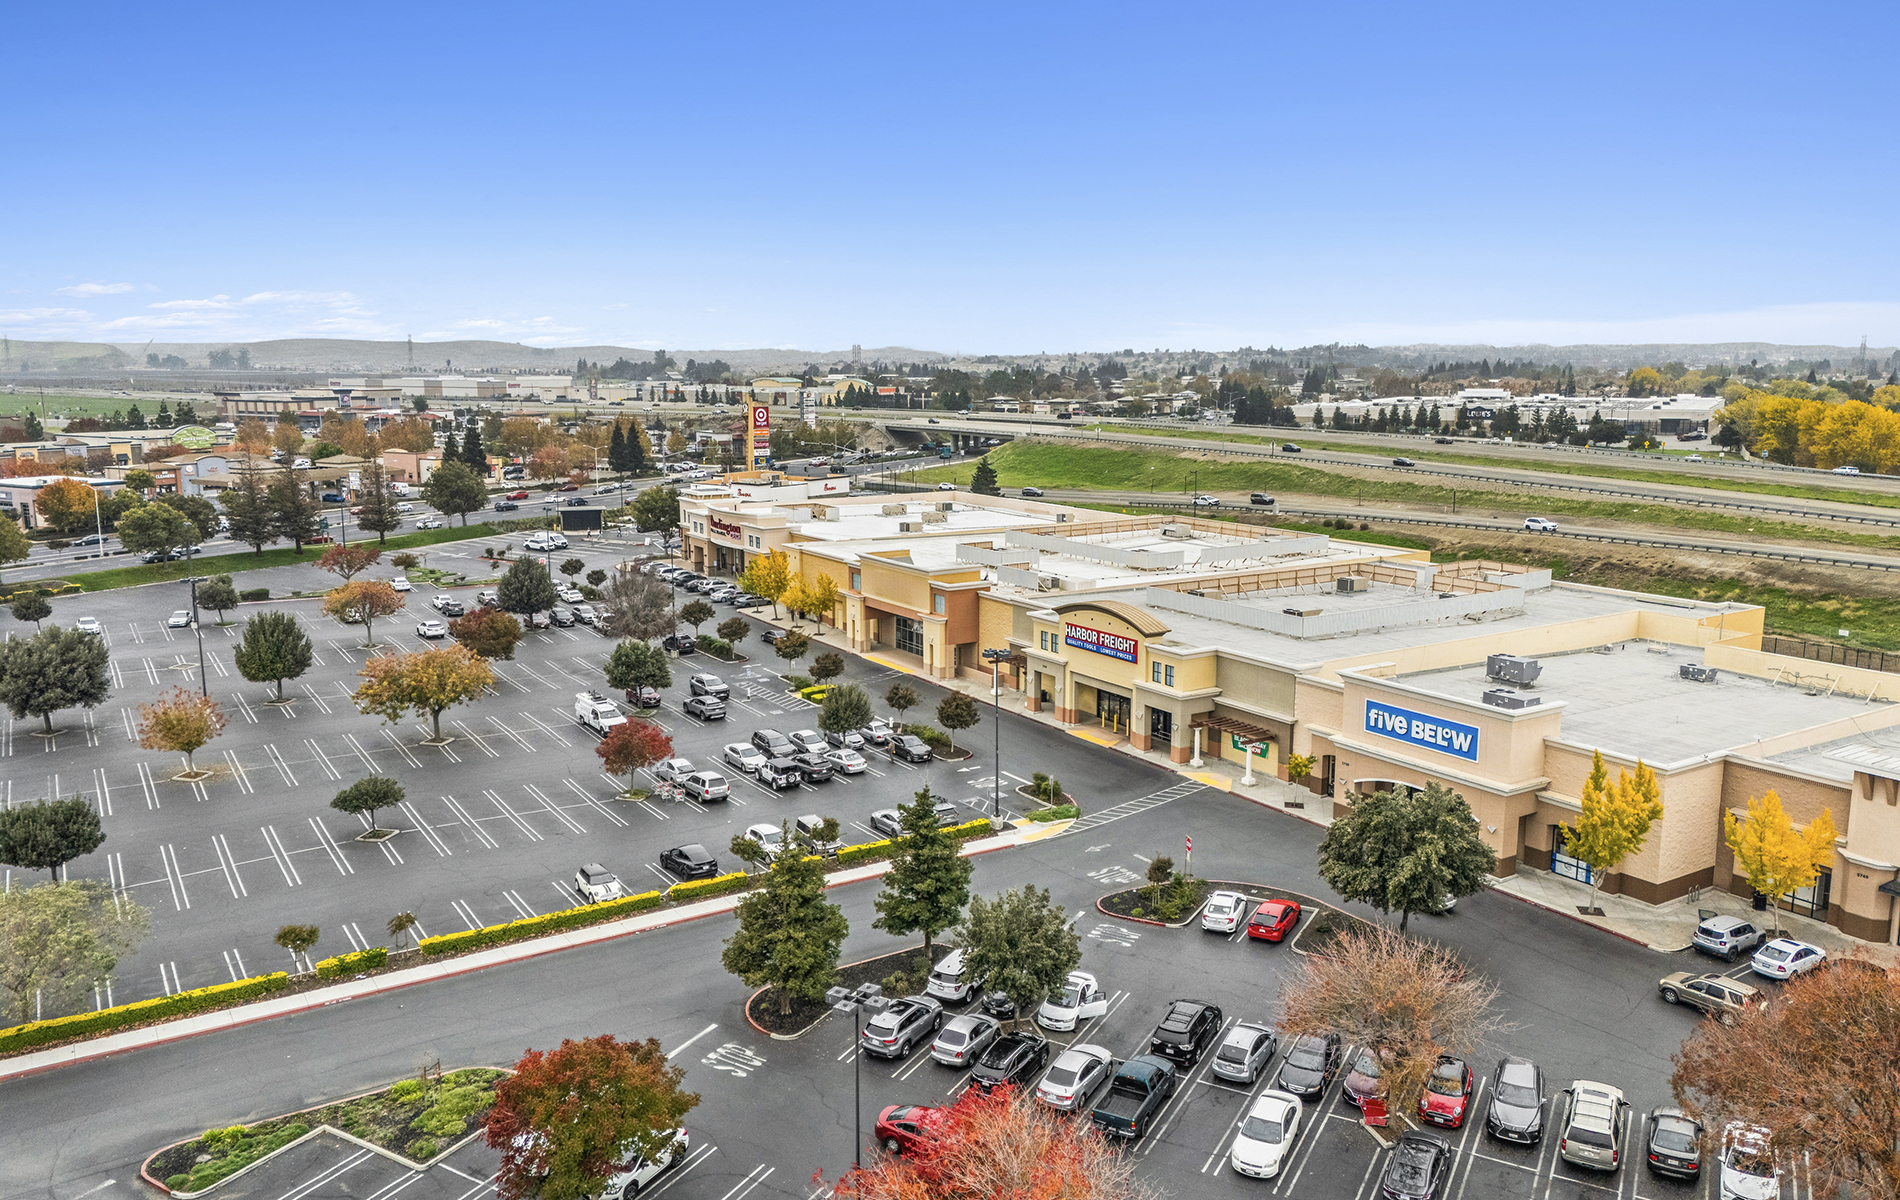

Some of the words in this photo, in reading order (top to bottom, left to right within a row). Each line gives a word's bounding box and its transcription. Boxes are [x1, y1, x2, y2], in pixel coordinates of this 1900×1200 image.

[1065, 624, 1098, 643] HARBOR
[1099, 633, 1135, 653] FREIGHT
[1067, 638, 1084, 648] QUALITY
[1084, 642, 1097, 650] TOOLS
[1100, 647, 1116, 656] LOWEST
[1116, 651, 1132, 661] PRICES
[1368, 708, 1408, 735] five
[1411, 720, 1472, 752] BELOW
[700, 1043, 767, 1077] STOP
